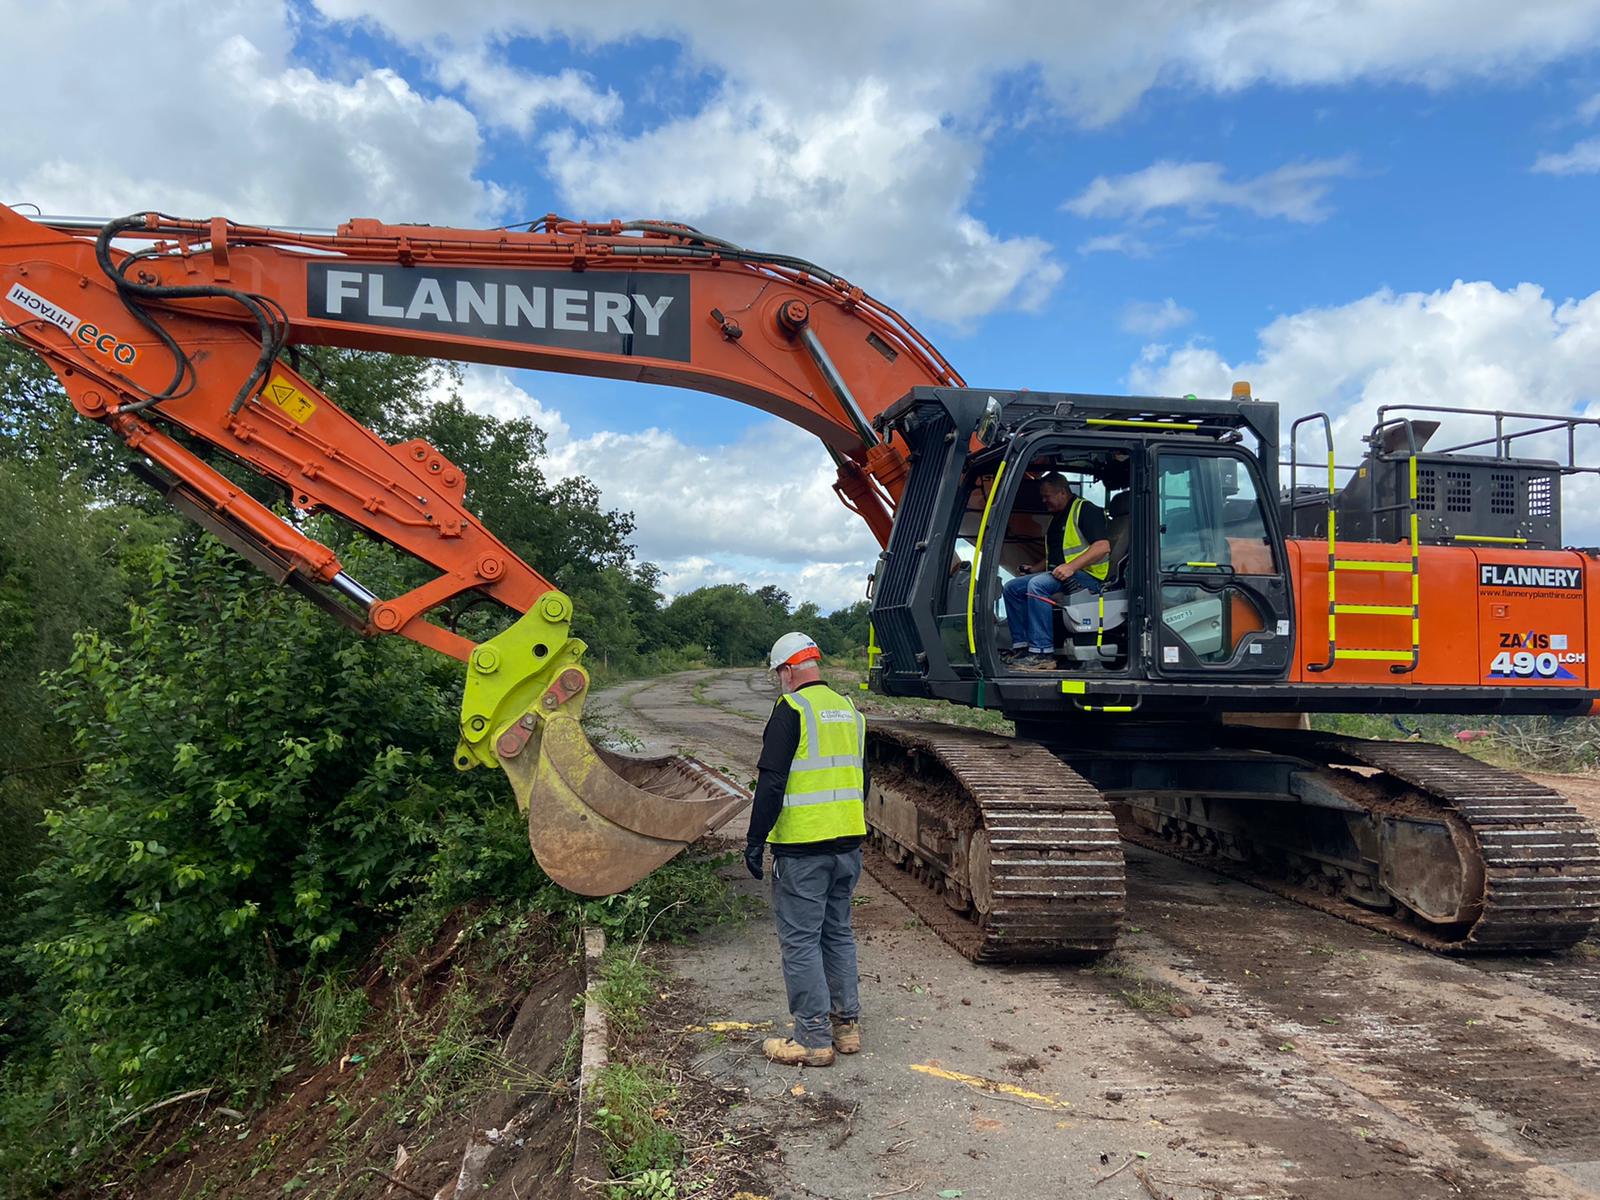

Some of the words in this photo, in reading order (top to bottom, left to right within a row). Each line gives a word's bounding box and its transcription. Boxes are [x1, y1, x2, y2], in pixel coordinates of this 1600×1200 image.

[12, 288, 74, 329] HITACHI
[326, 270, 674, 336] FLANNERY
[76, 323, 136, 364] eco
[1481, 565, 1579, 587] FLANNERY
[1480, 589, 1583, 600] www.flanneryplanthire.com
[1499, 631, 1549, 649] ZAXIS
